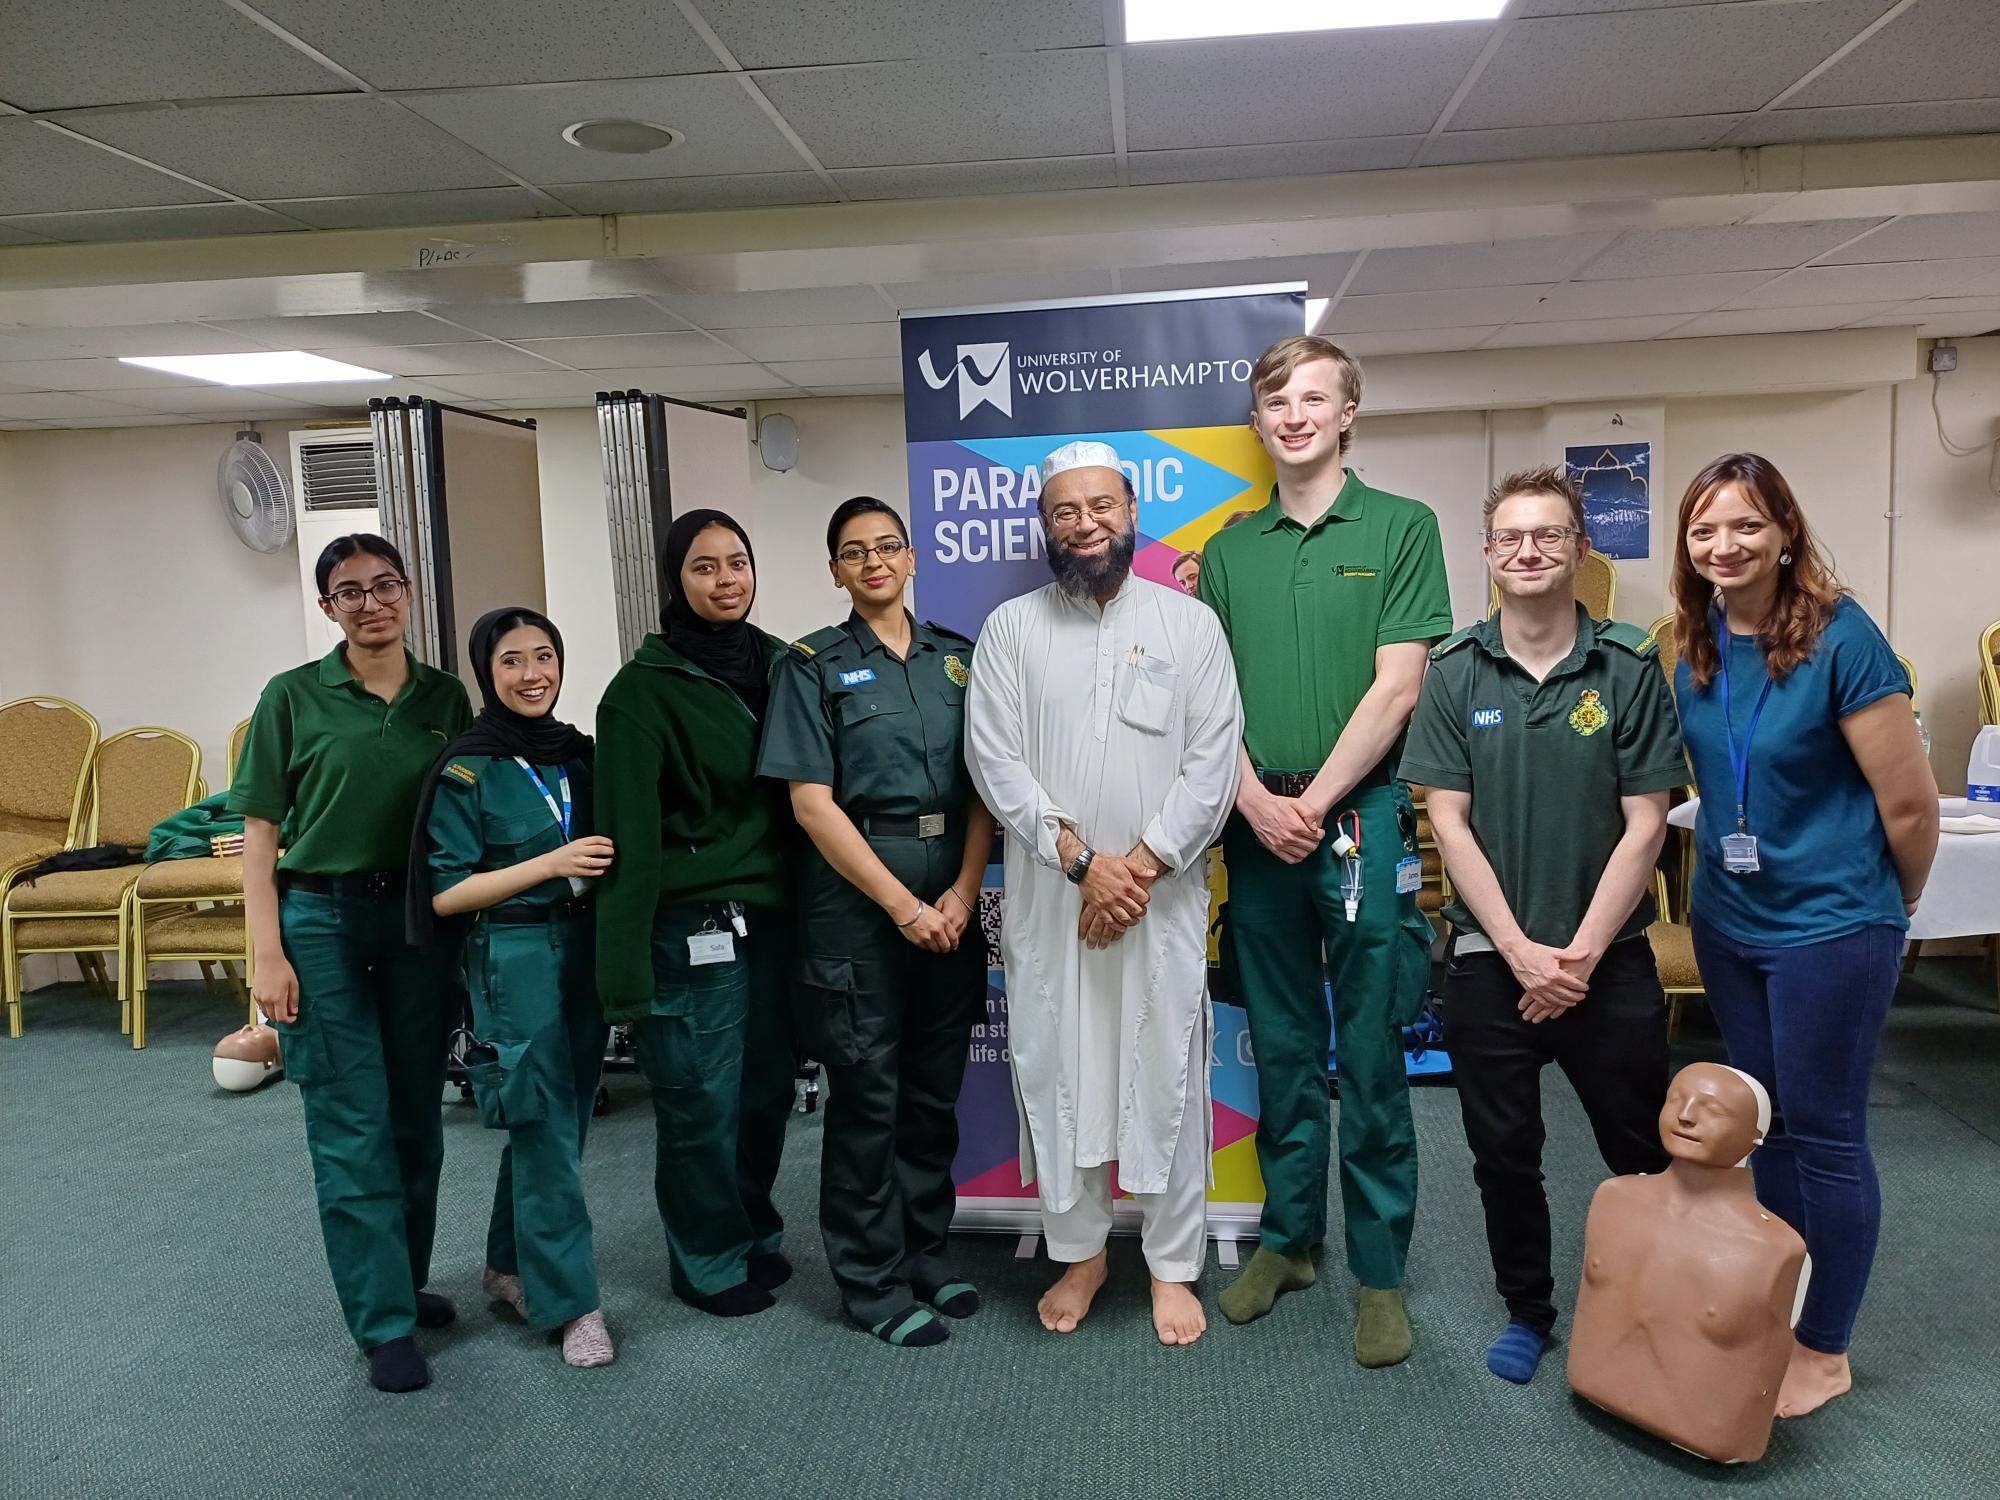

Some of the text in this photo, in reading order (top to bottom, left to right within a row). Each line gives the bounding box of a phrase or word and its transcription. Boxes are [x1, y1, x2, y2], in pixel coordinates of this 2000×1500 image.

[1017, 349, 1122, 368] UNIVERSITY OF
[1018, 359, 1259, 395] WOLVERHAMPTO
[933, 457, 1184, 511] PARAIC
[935, 517, 1049, 563] SCIEN
[844, 669, 872, 684] NHS
[1474, 709, 1501, 725] NHS
[969, 1044, 997, 1062] life
